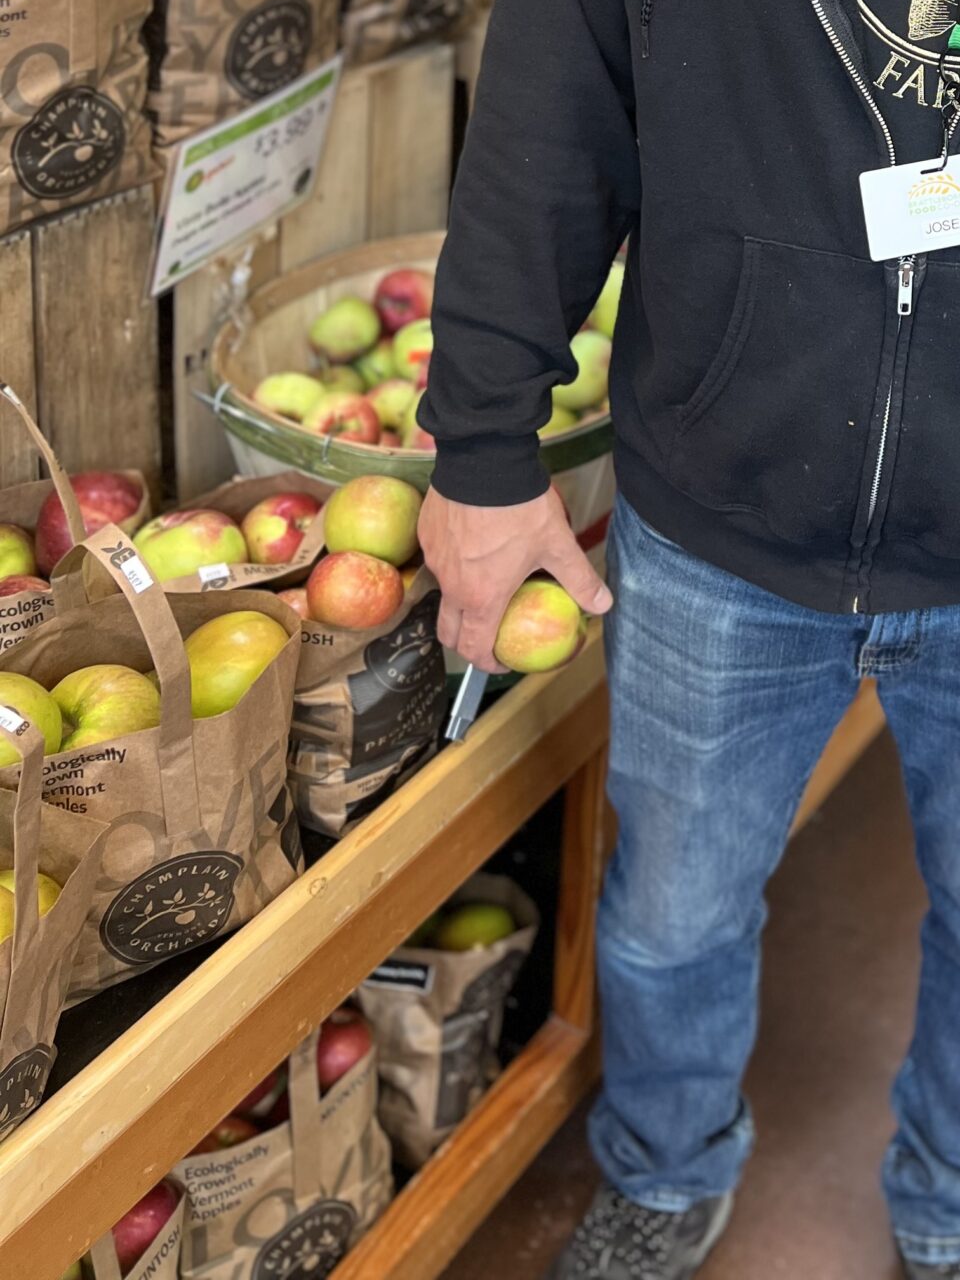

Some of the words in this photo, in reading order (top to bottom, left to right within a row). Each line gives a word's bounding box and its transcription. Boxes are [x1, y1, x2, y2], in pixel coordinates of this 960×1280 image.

[925, 218, 960, 234] JOSE
[16, 721, 30, 736] eco
[43, 747, 127, 776] ologically
[44, 768, 84, 787] own
[41, 782, 106, 802] ermont
[49, 798, 88, 814] les
[123, 865, 230, 914] CHAMPLAIN
[184, 1143, 270, 1180] Ecologically
[186, 1172, 237, 1197] Grown
[186, 1176, 255, 1210] Vermont
[190, 1198, 242, 1223] Apples
